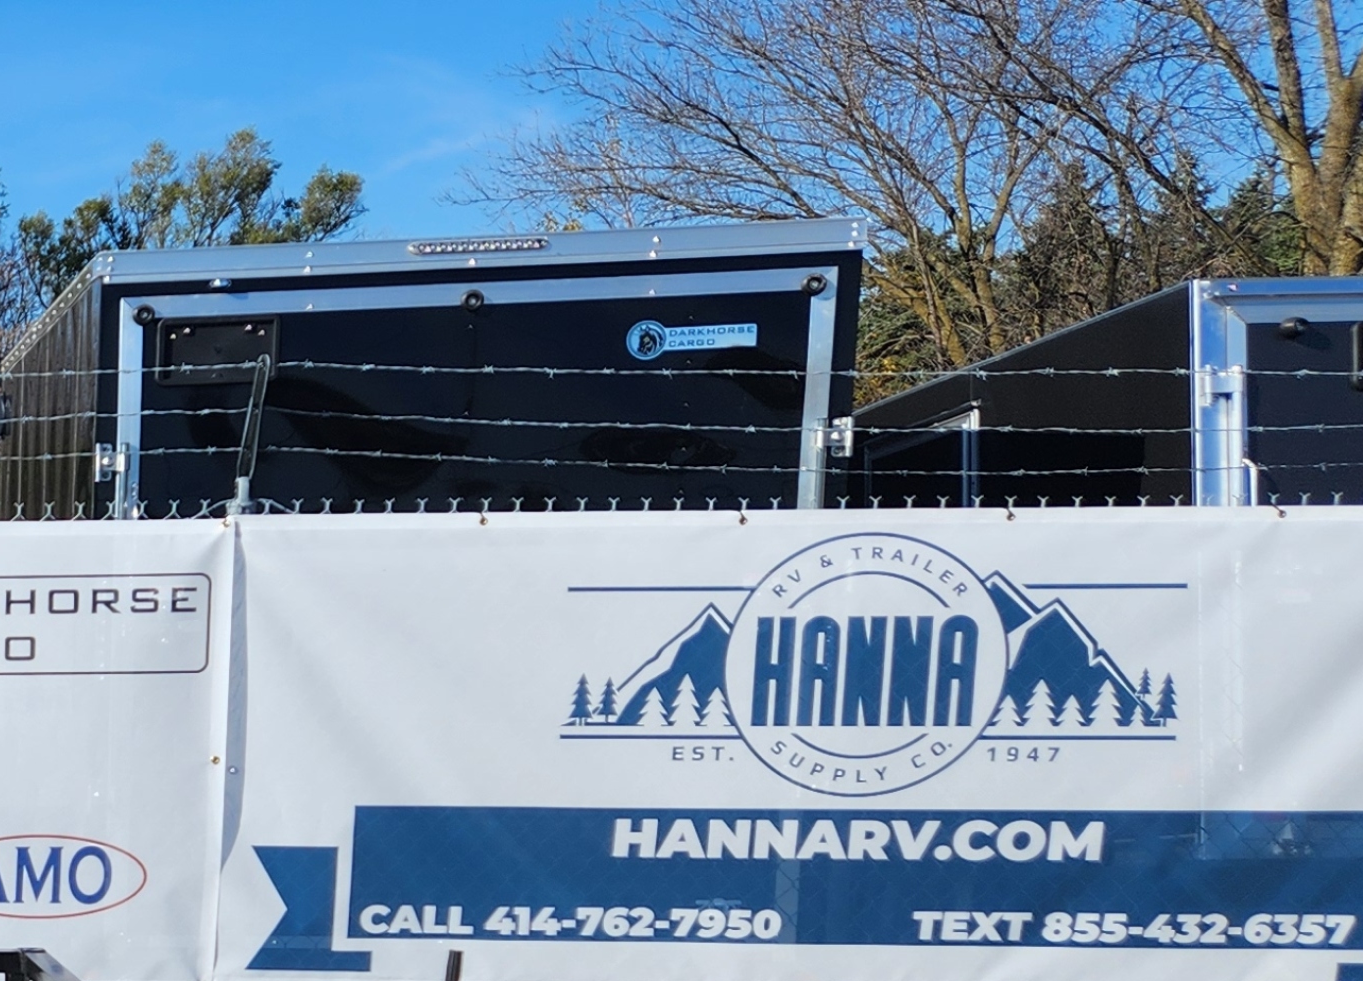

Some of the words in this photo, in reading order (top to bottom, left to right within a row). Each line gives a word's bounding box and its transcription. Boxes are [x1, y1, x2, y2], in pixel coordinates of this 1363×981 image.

[668, 338, 716, 348] CARGO
[669, 325, 755, 337] DARKHORSE
[771, 570, 801, 599] RV
[819, 554, 834, 569] &
[852, 546, 969, 597] TRAILER
[750, 615, 979, 727] HANNA
[672, 746, 735, 762] EST.
[770, 740, 888, 784] SUPPLY
[912, 740, 953, 769] CO.
[987, 747, 1061, 763] 1947
[612, 818, 1106, 863] HANNARV.COM
[360, 905, 474, 935] CALL
[484, 906, 782, 939] 414-762-7950
[912, 911, 1034, 941] TEXT
[1042, 913, 1356, 946] 855-432-6357
